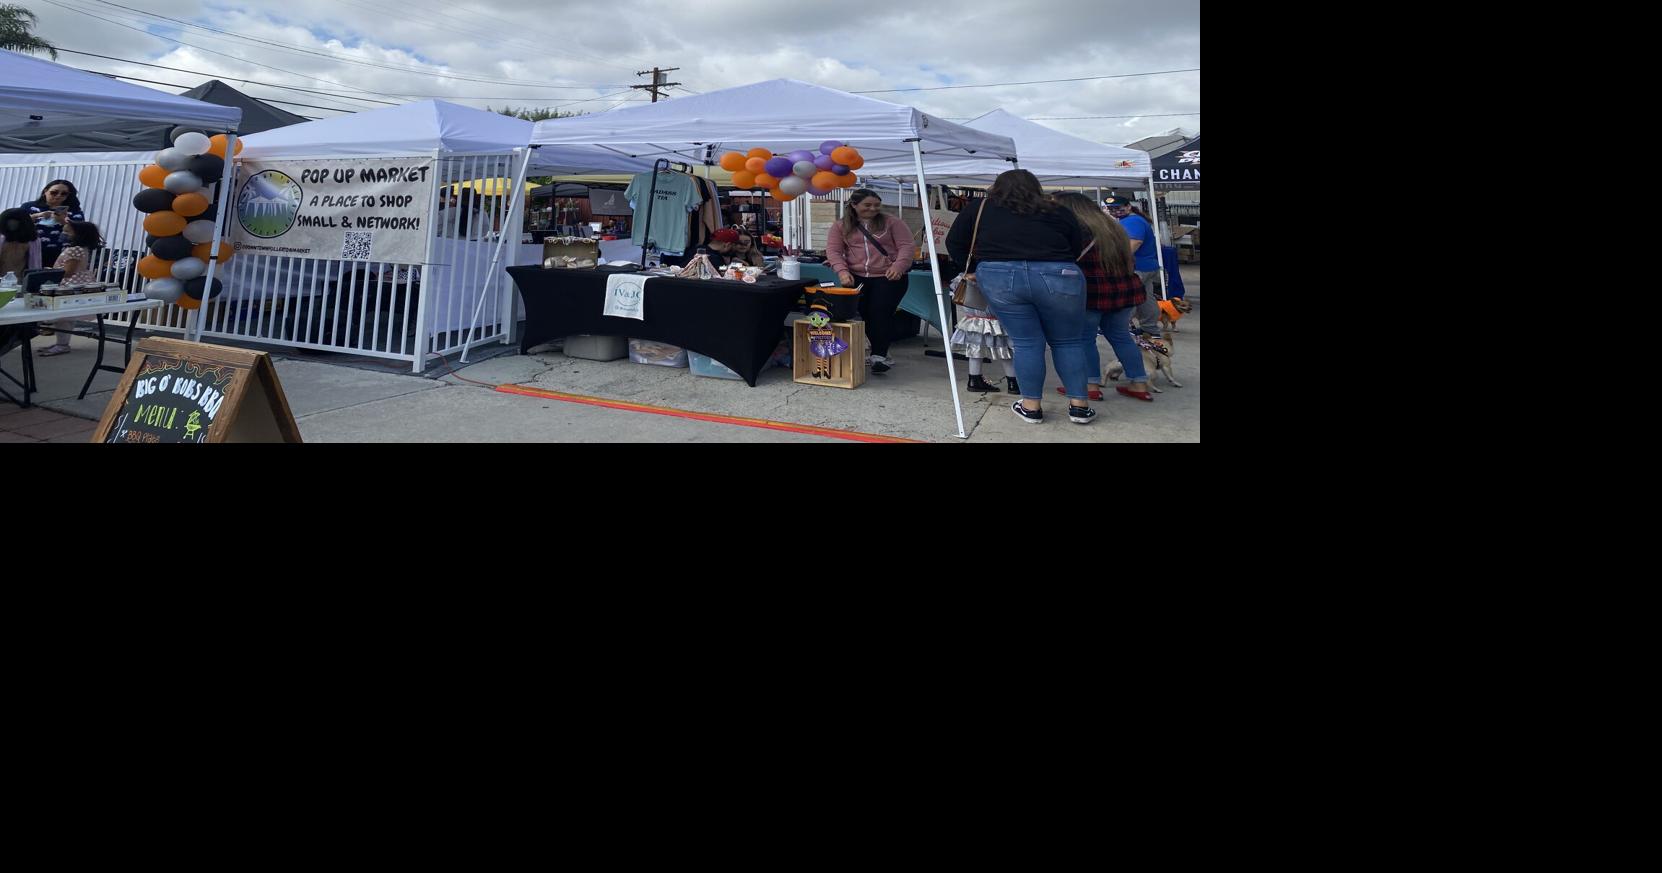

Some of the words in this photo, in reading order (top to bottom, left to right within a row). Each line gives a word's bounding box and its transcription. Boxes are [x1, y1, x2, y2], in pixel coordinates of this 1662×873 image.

[301, 168, 330, 183] POP
[333, 168, 355, 183] UP
[360, 166, 430, 183] MARKET
[309, 195, 318, 207] A
[321, 195, 359, 208] PLACE
[361, 195, 376, 208] TO
[380, 195, 413, 208] SHOP
[297, 214, 337, 228] SMALL
[341, 216, 352, 228] &
[357, 216, 420, 230] NETWORK!
[135, 376, 157, 399] BIG
[172, 376, 203, 401] BOBS
